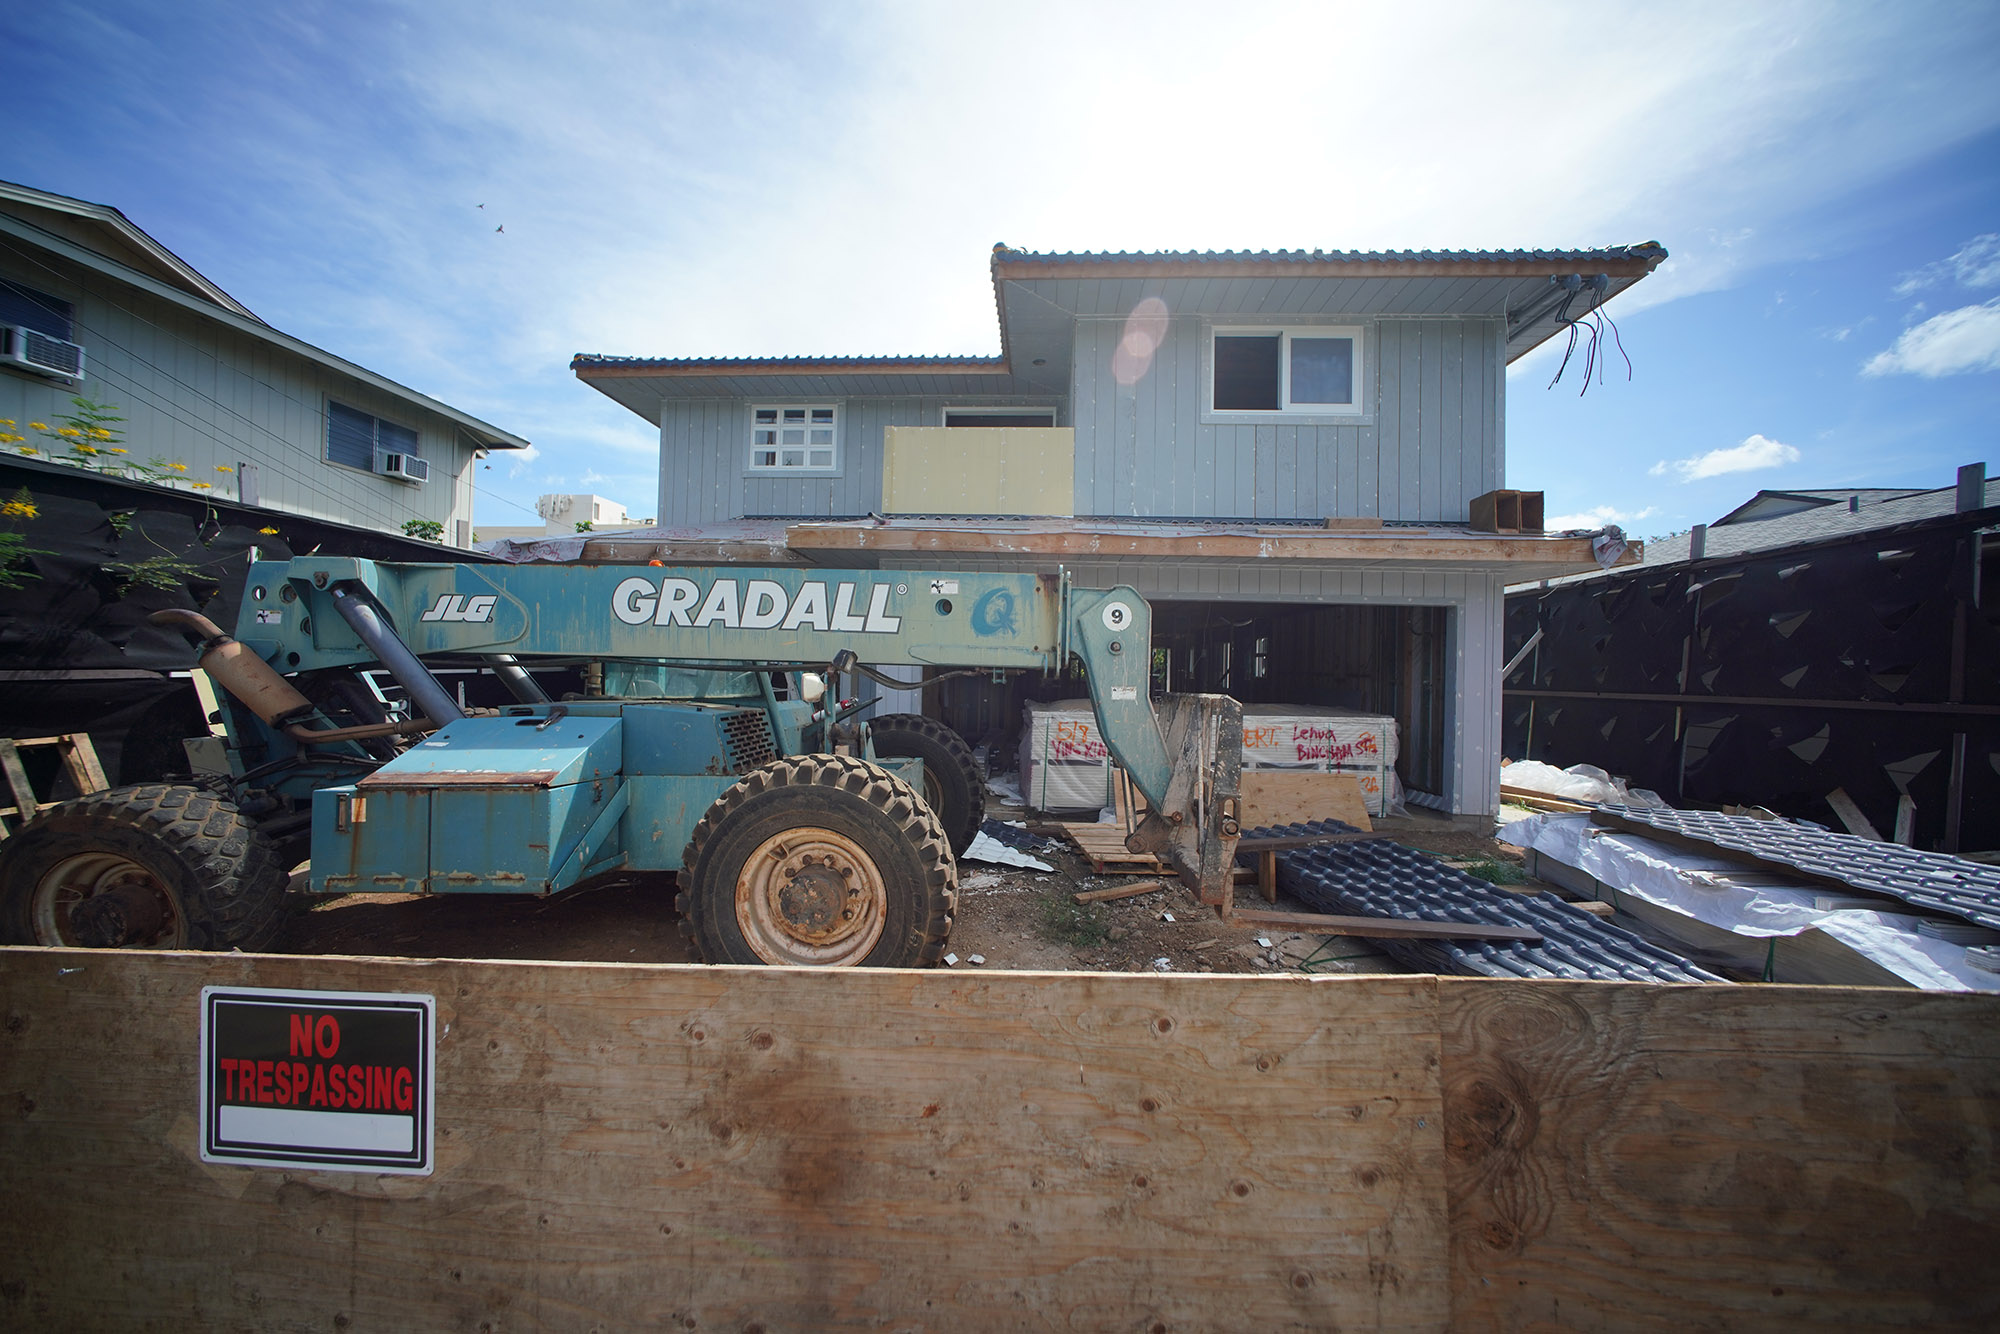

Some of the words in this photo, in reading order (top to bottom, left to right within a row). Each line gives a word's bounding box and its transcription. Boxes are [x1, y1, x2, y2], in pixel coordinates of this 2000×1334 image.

[420, 593, 498, 622] JLG
[612, 577, 902, 634] GRADALL
[971, 587, 1016, 637] Q
[1110, 609, 1124, 624] 9
[1056, 721, 1089, 746] 5/8
[290, 1014, 341, 1059] NO
[220, 1058, 414, 1112] TRESPASSING
